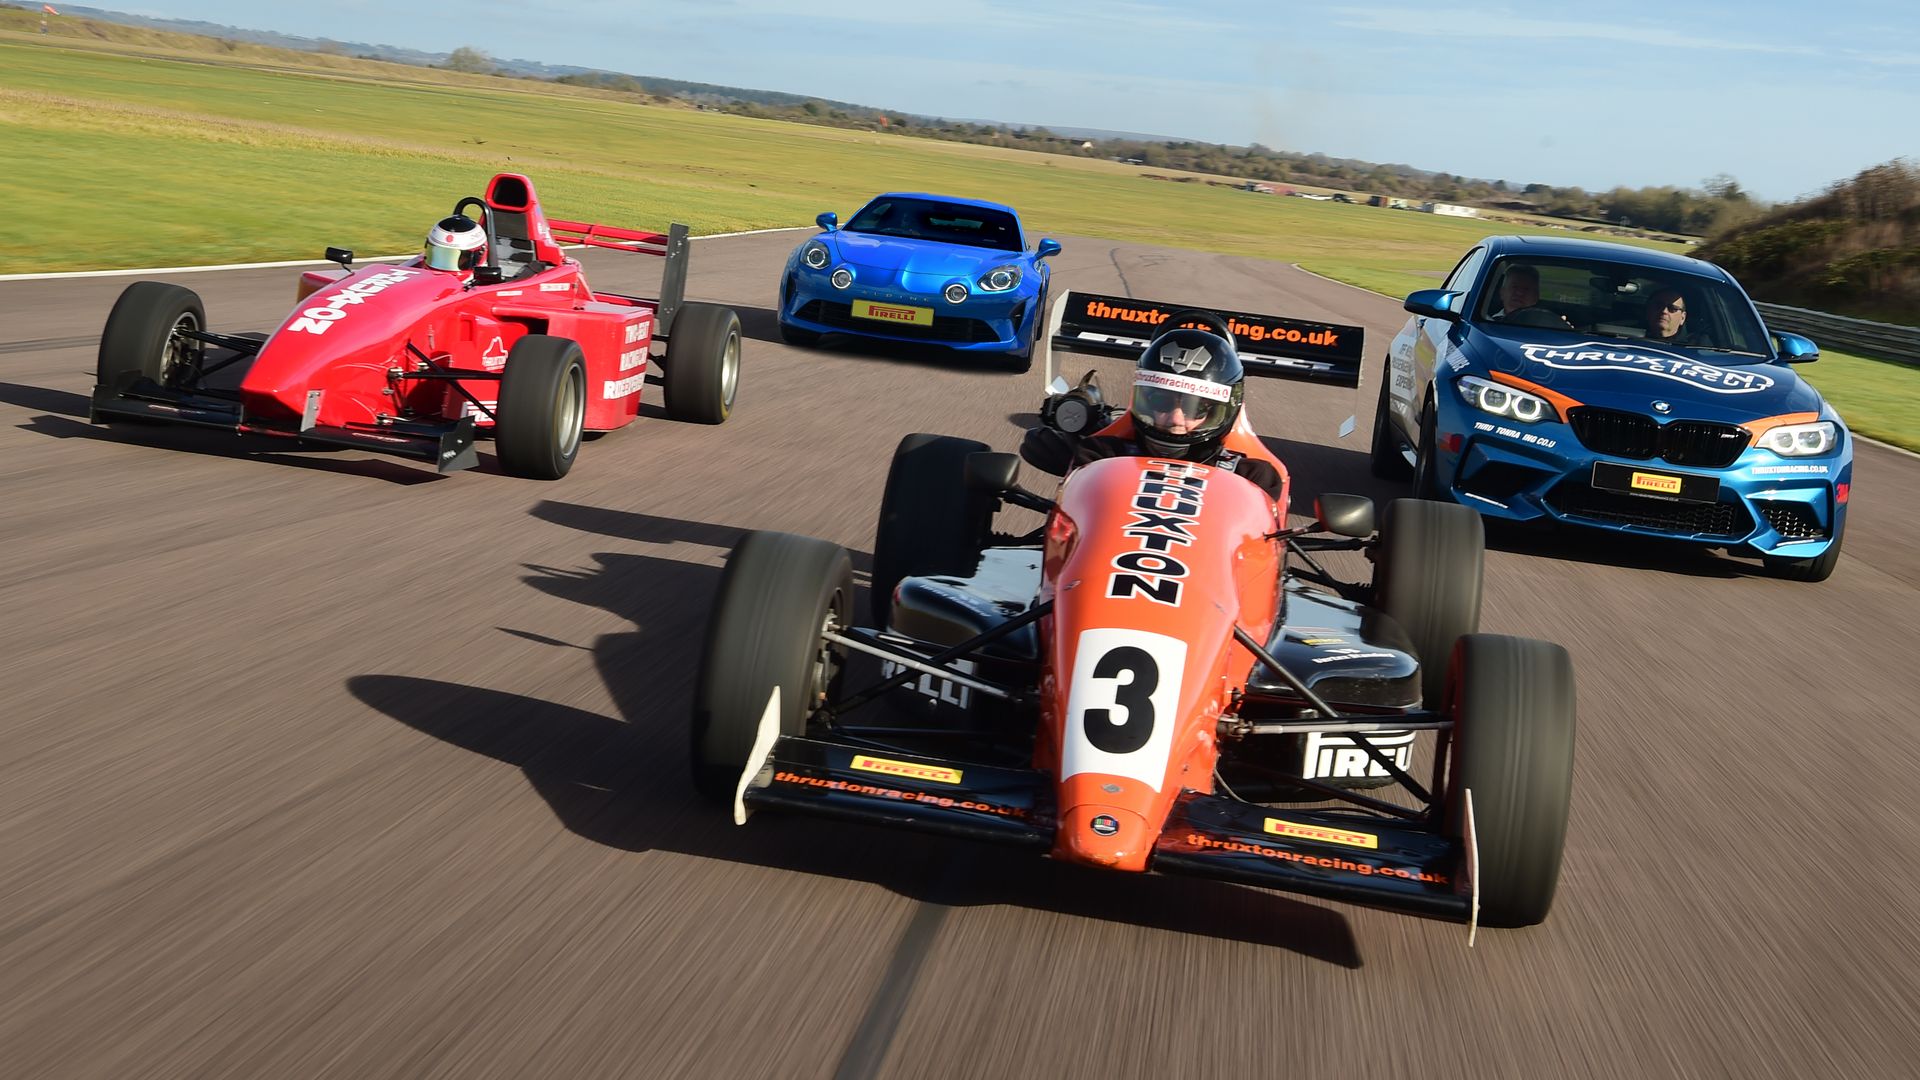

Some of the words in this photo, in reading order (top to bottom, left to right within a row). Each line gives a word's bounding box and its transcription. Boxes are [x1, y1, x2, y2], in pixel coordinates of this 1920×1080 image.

[868, 305, 916, 321] PIRELLI
[1524, 347, 1756, 389] THRUXTON
[1636, 476, 1677, 490] PIRELLI
[1105, 460, 1209, 608] THRUXTON
[1083, 646, 1159, 754] 3
[863, 760, 953, 780] PIRELLI
[774, 771, 1026, 818] thruxtonracing.co.uk
[1275, 823, 1367, 845] PIRELLI
[1187, 833, 1449, 884] thruxtonracing.co.uk
